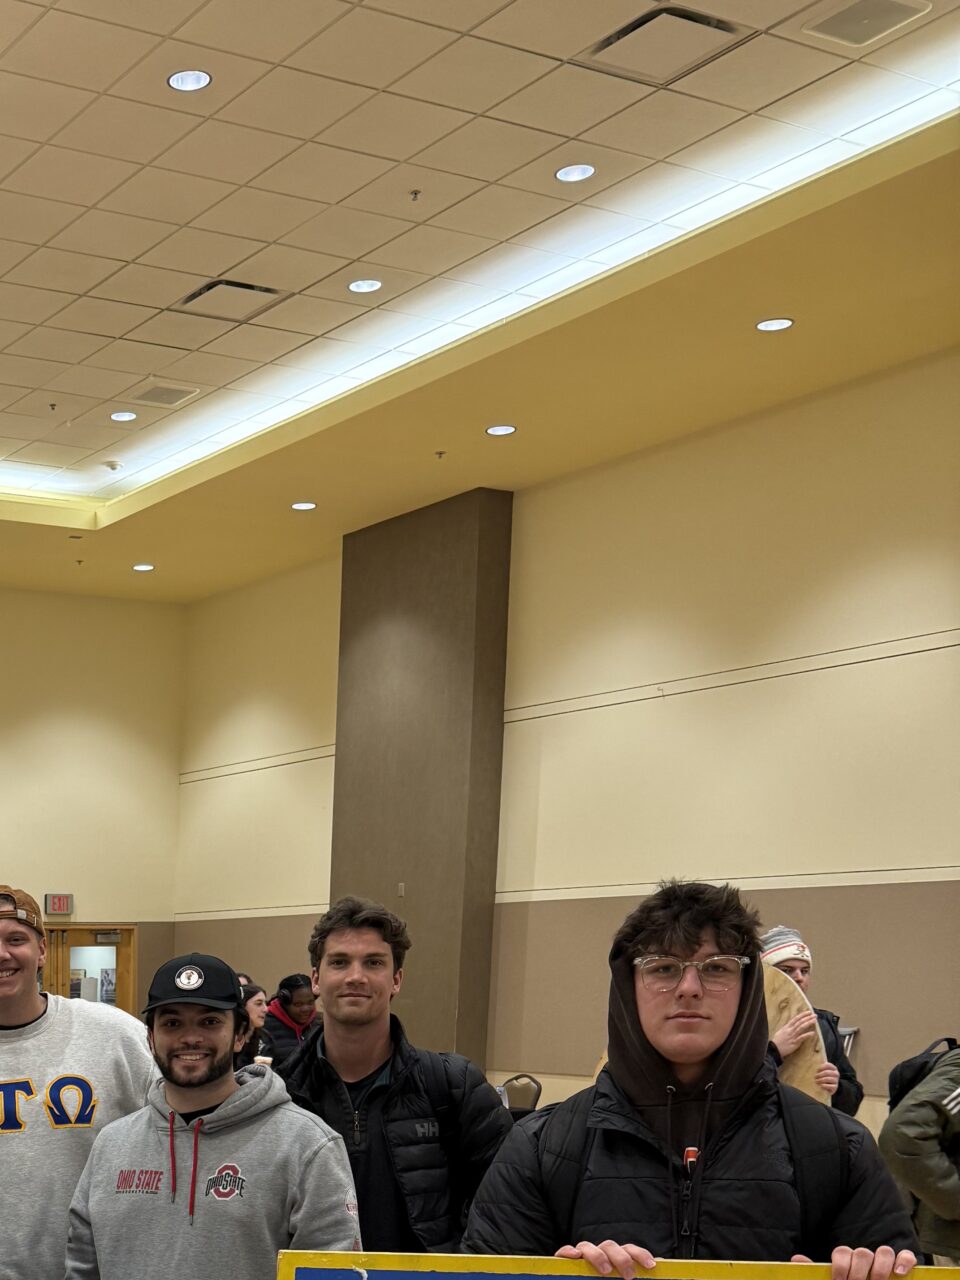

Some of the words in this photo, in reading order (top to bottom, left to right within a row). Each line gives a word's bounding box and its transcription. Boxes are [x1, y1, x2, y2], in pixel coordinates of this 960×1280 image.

[51, 895, 69, 912] EXIT
[415, 1121, 440, 1137] HH
[116, 1169, 137, 1190] OHIO
[135, 1169, 164, 1191] STATE
